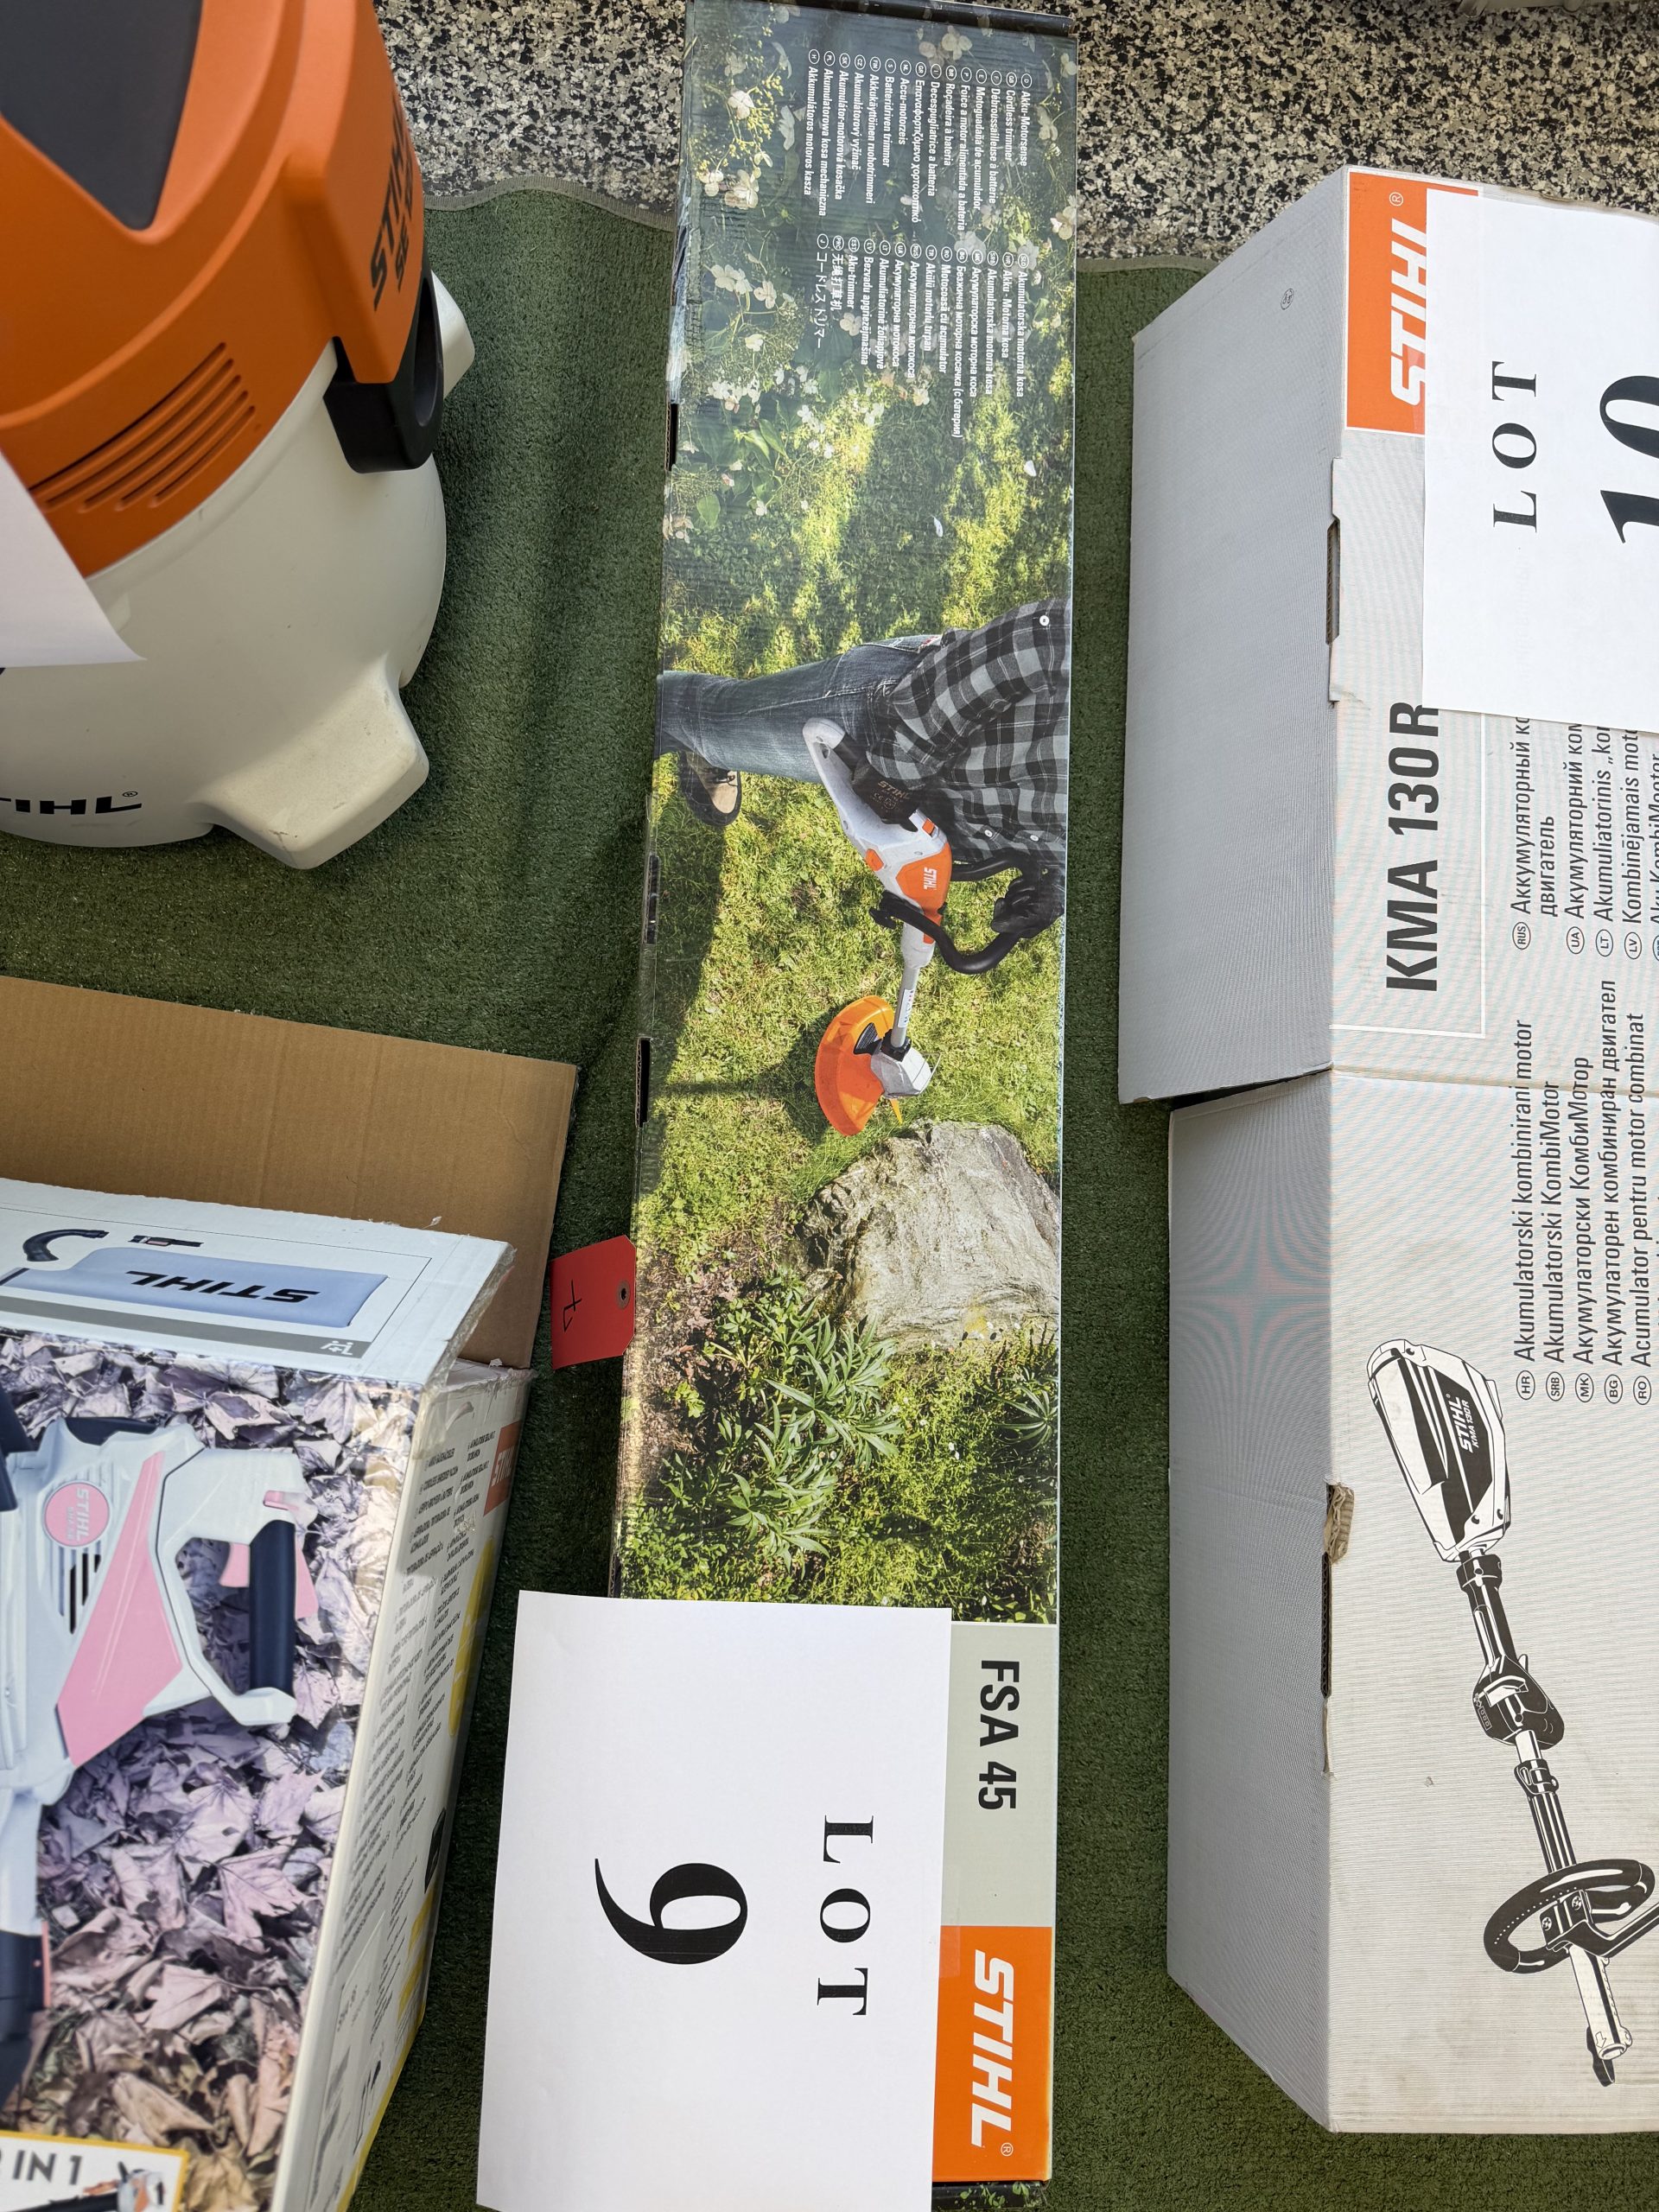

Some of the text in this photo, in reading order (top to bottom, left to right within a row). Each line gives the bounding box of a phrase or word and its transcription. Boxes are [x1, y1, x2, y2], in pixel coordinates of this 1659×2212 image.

[822, 68, 834, 136] Akumulatorowa
[883, 76, 894, 131] Batteridriven
[898, 77, 909, 145] Accu-motorzeis
[927, 81, 940, 155] Decespugliatrice
[960, 84, 970, 108] Foice
[1006, 89, 1015, 126] Cordless
[804, 133, 816, 168] motoros
[820, 138, 831, 159] kosa
[881, 133, 893, 167] trimmer
[944, 136, 954, 166] bateria
[959, 117, 969, 143] motor
[975, 147, 984, 158] de
[1005, 128, 1014, 162] trimmer
[1019, 91, 1031, 167] Akku-Motorsense
[804, 170, 815, 195] kasza
[818, 160, 830, 216] mechaniczna
[866, 143, 877, 204] ruohotrimmeri
[927, 163, 938, 197] batteria
[958, 143, 969, 191] alimentada
[973, 159, 983, 210] acumulador
[988, 170, 999, 204] batterie
[957, 200, 968, 231] bateria
[830, 252, 844, 311] 无绳打草机
[847, 254, 858, 309] Aku-trimmer
[863, 256, 874, 293] Bezvadu
[986, 268, 997, 334] Akumulatorska
[1002, 269, 1012, 292] Akku
[925, 289, 934, 323] motorlu
[953, 312, 963, 349] моторна
[1001, 298, 1012, 336] Motorna
[1016, 270, 1027, 336] Akumulatorska
[892, 324, 900, 367] мотокоса
[907, 335, 917, 378] мотокоса
[938, 325, 950, 373] acumulator
[969, 336, 979, 374] моторна
[985, 335, 995, 372] motorna
[1001, 337, 1011, 358] kosa
[1016, 338, 1026, 374] motorna
[985, 373, 995, 395] kosa
[1016, 376, 1026, 397] kosa
[1492, 361, 1536, 532] LOT
[1510, 741, 1535, 915] Аккумуляторный
[1563, 761, 1588, 919] Акумуляторний
[1592, 770, 1613, 922] Akumuliatorinis
[1620, 778, 1644, 925] Kombinējamais
[924, 867, 938, 890] STIHL
[1539, 817, 1558, 917] двигатель
[1386, 860, 1438, 992] KMA
[1514, 1020, 1532, 1080] motor
[1600, 980, 1620, 1071] двигател
[1624, 1013, 1644, 1103] combinat
[1509, 1085, 1533, 1204] kombinirani
[1539, 1081, 1561, 1205] KombiMotor
[1567, 1057, 1593, 1190] КомбиМотор
[1598, 1077, 1621, 1203] комбиниран
[1627, 1109, 1646, 1168] motor
[1629, 1176, 1652, 1241] pentru
[125, 1271, 321, 1303] STIHL
[1512, 1210, 1535, 1363] Akumulatorski
[1541, 1212, 1565, 1363] Akumulatorski
[1573, 1198, 1598, 1364] Акумулаторски
[1601, 1211, 1626, 1366] Акумулаторен
[1630, 1247, 1651, 1367] Acumulator
[1448, 1396, 1473, 1453] STIHL
[1467, 1425, 1479, 1448] KMA
[76, 1488, 90, 1542] STIHL
[977, 1660, 1020, 1810] FSA 45
[594, 1858, 747, 1965] 9
[817, 1815, 874, 2016] LOT
[970, 1949, 1014, 2148] STIHL
[12, 2150, 57, 2183] IN
[69, 2155, 83, 2185] 1
